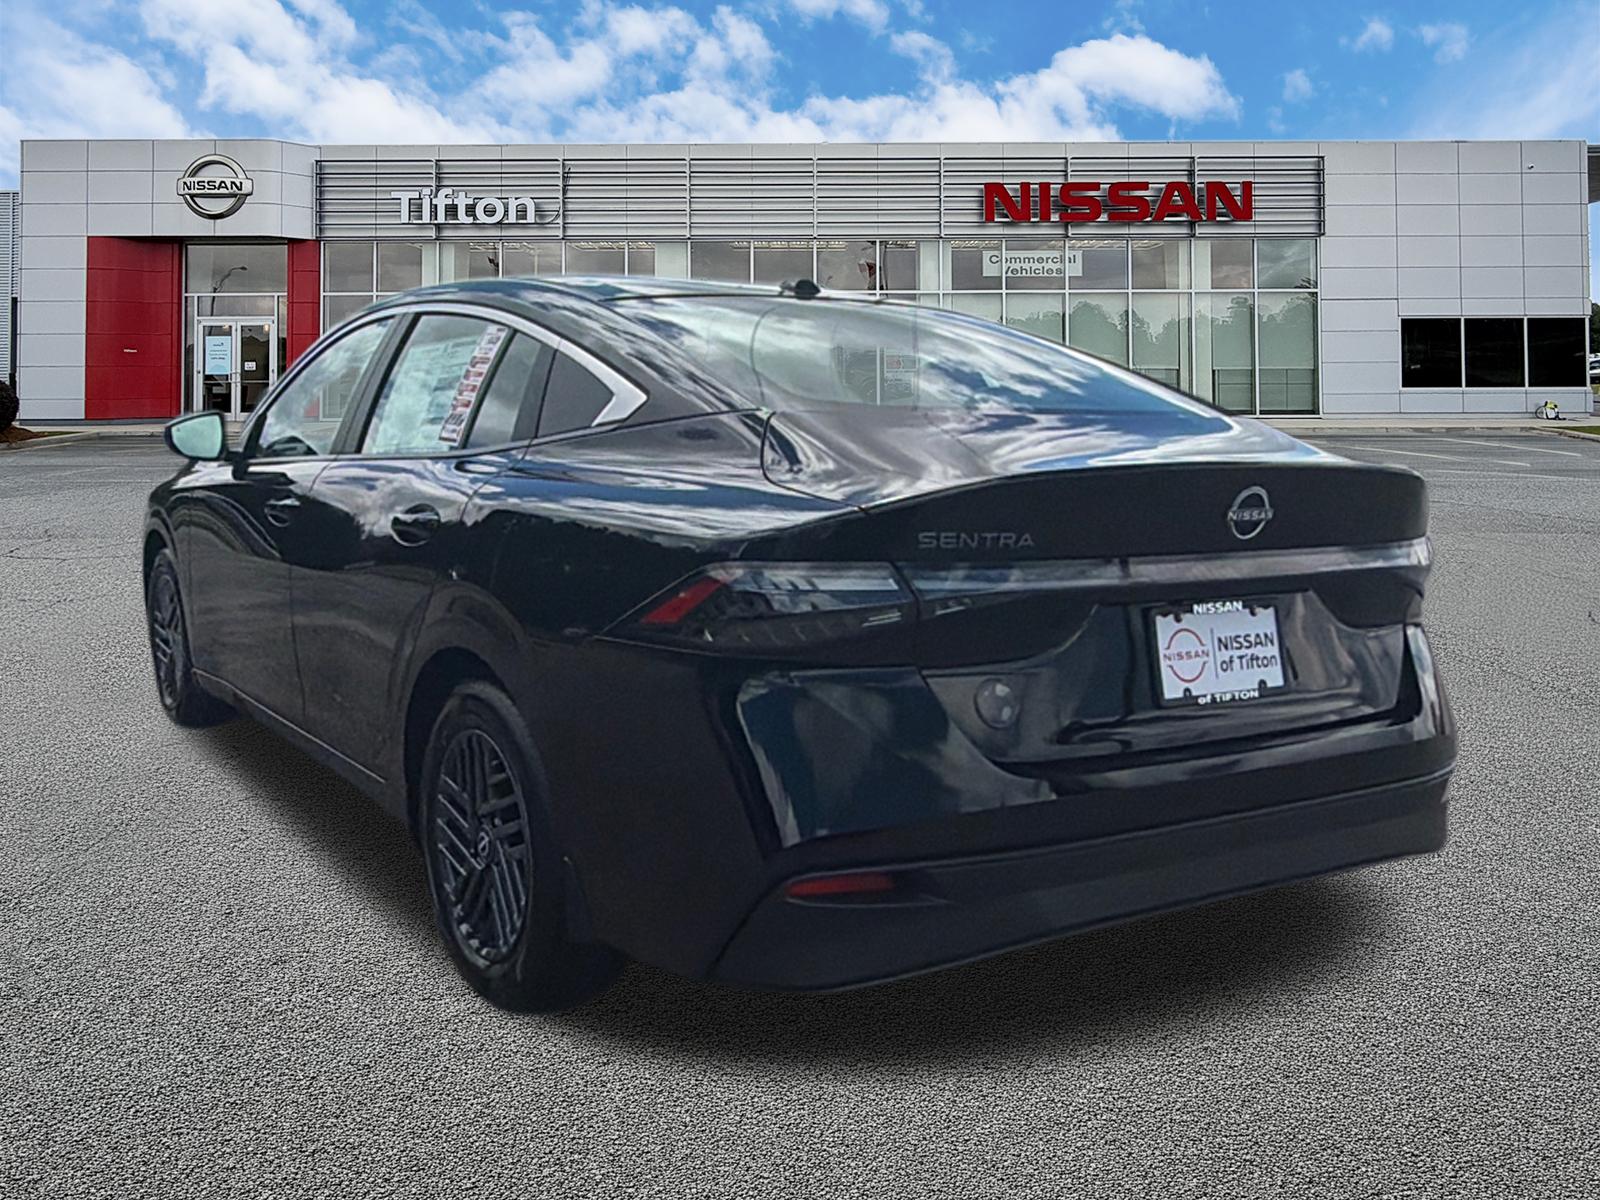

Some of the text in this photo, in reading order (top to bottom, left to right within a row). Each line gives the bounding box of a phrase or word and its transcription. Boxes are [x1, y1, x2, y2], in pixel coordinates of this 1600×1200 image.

[182, 180, 243, 192] NISSAN
[391, 187, 536, 225] Tifton
[983, 181, 1253, 223] NISSAN
[917, 531, 1035, 550] SENTRA
[1192, 600, 1243, 615] NISSAN
[1217, 632, 1275, 652] NISSAN
[1163, 649, 1209, 662] NISSAN
[1220, 653, 1278, 673] of Tifton
[1214, 690, 1259, 703] TIFTON
